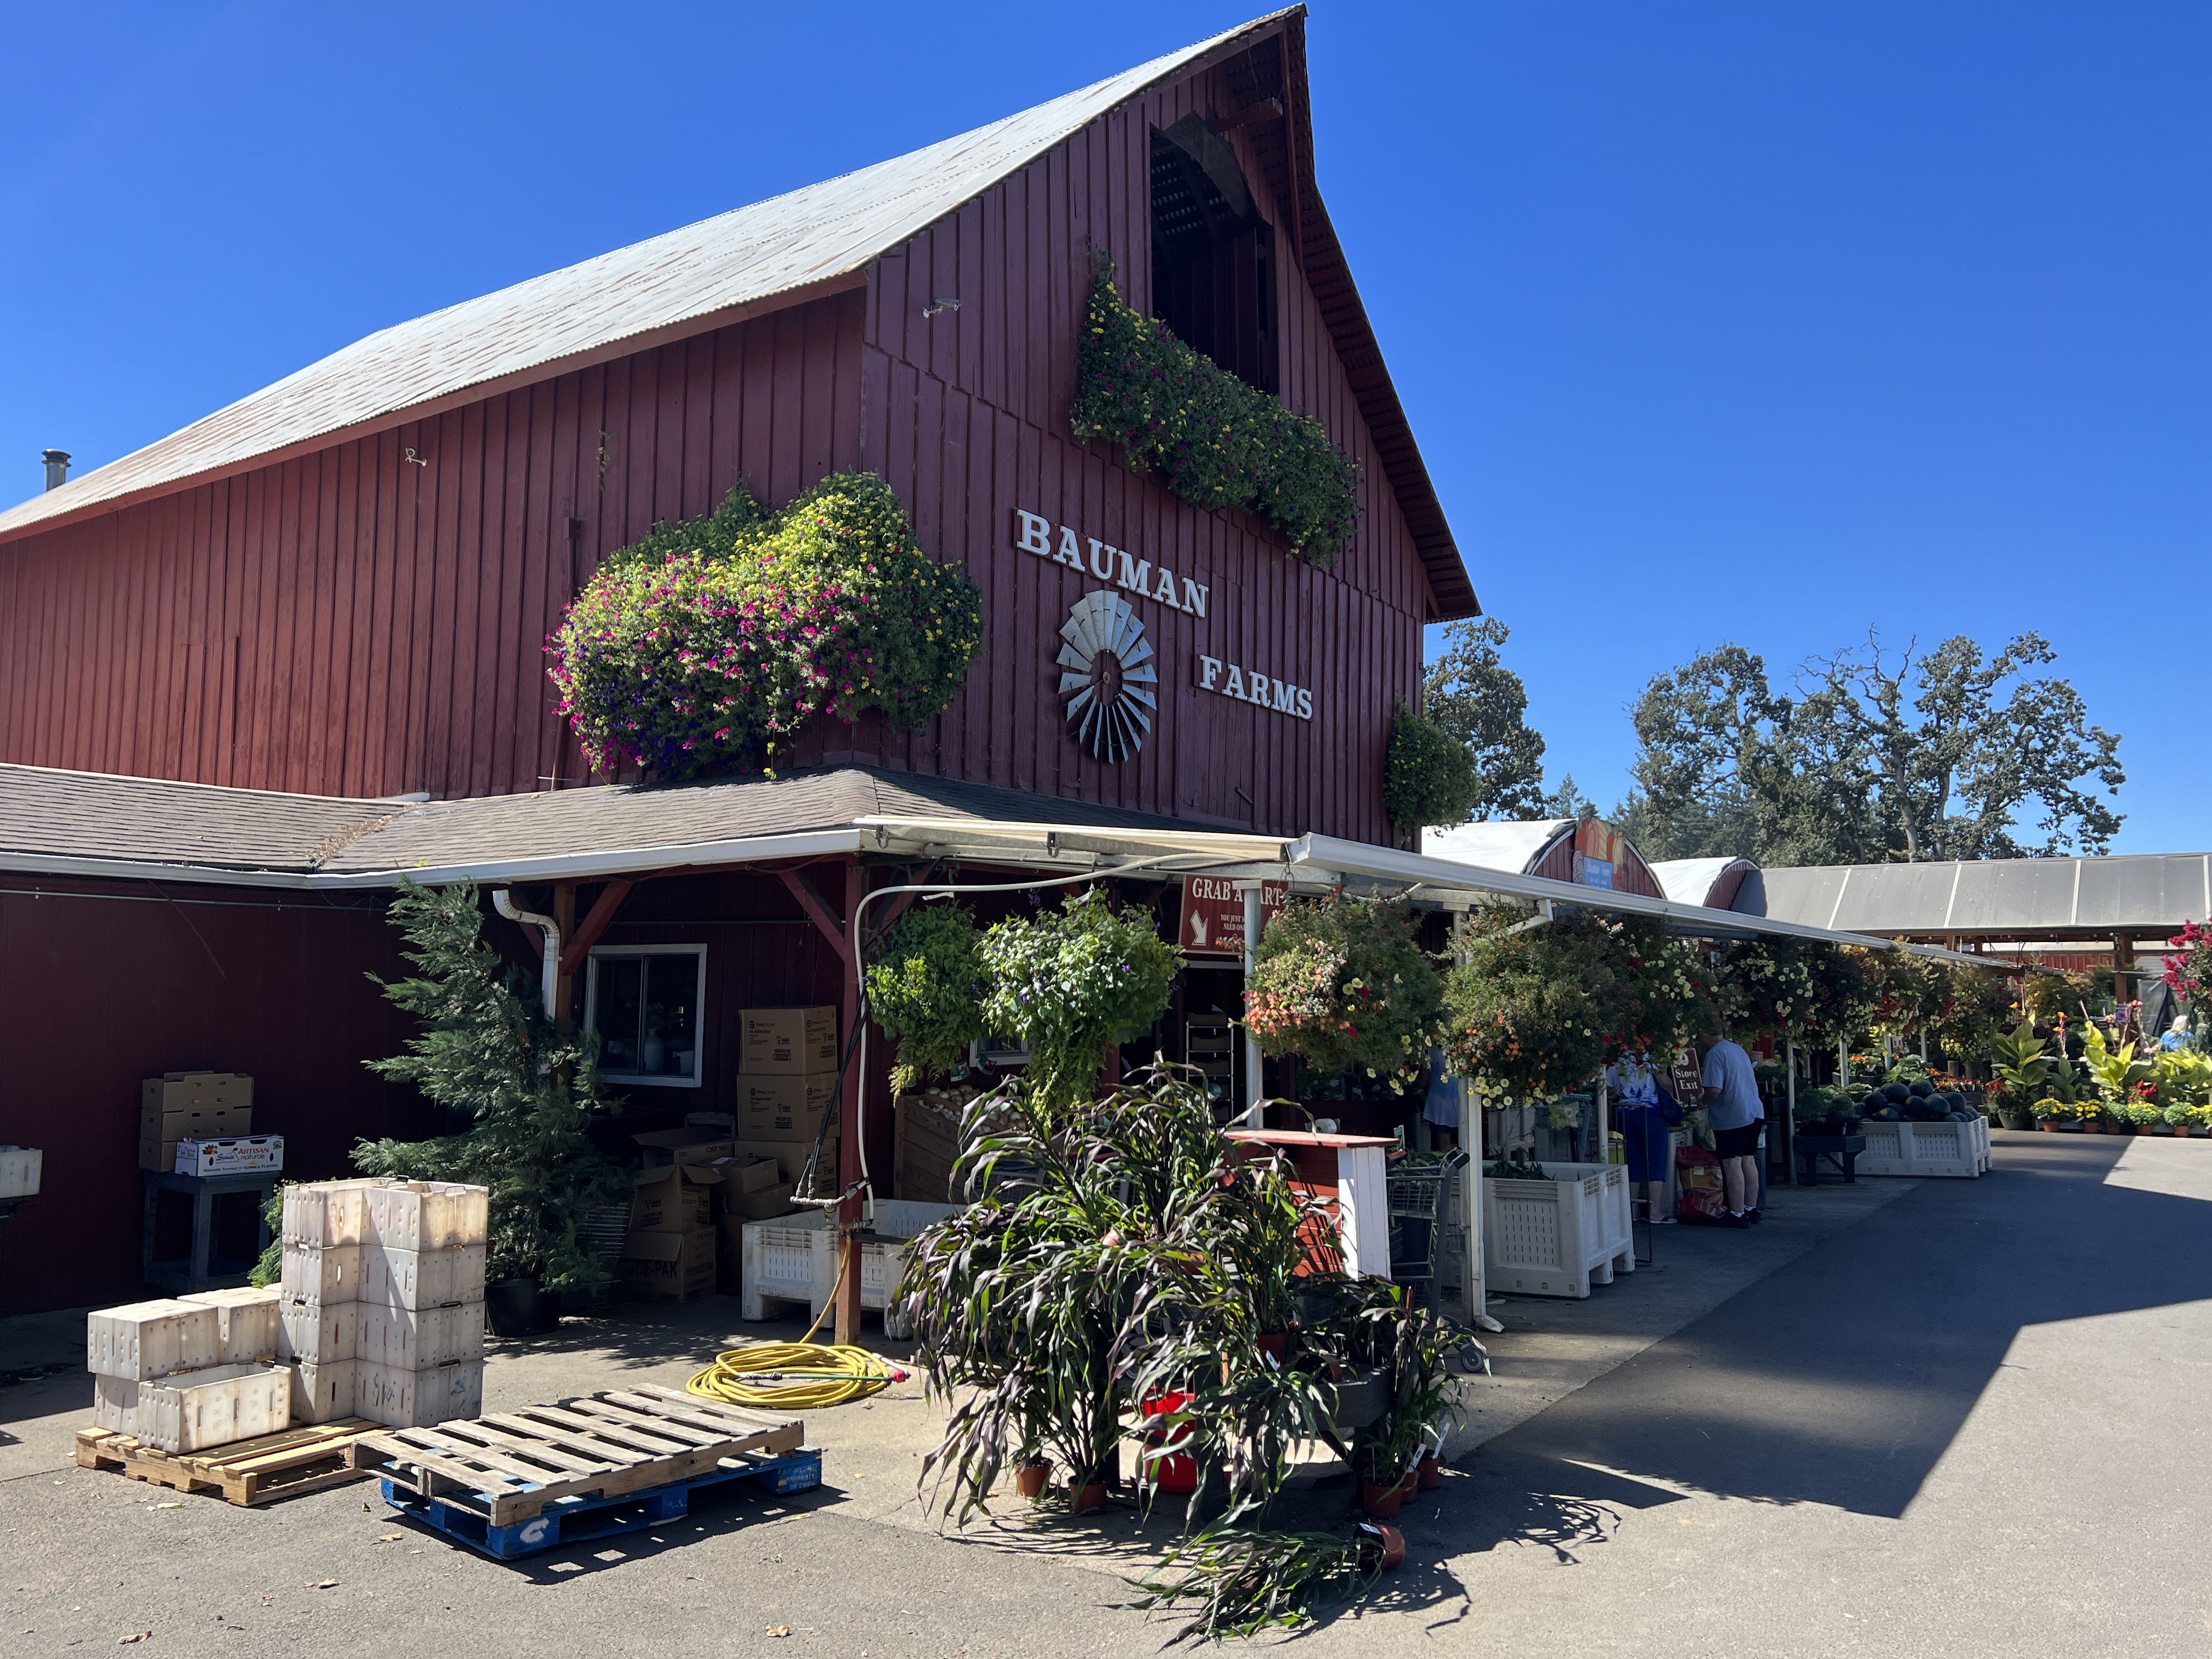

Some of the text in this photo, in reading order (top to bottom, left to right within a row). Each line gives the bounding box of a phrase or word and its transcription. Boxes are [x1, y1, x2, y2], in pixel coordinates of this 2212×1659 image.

[1017, 509, 1209, 619] BAUMAN
[1199, 654, 1313, 721] FARMS
[1192, 878, 1231, 901] GRAB
[1675, 1069, 1698, 1079] Store
[1679, 1080, 1699, 1090] Exit
